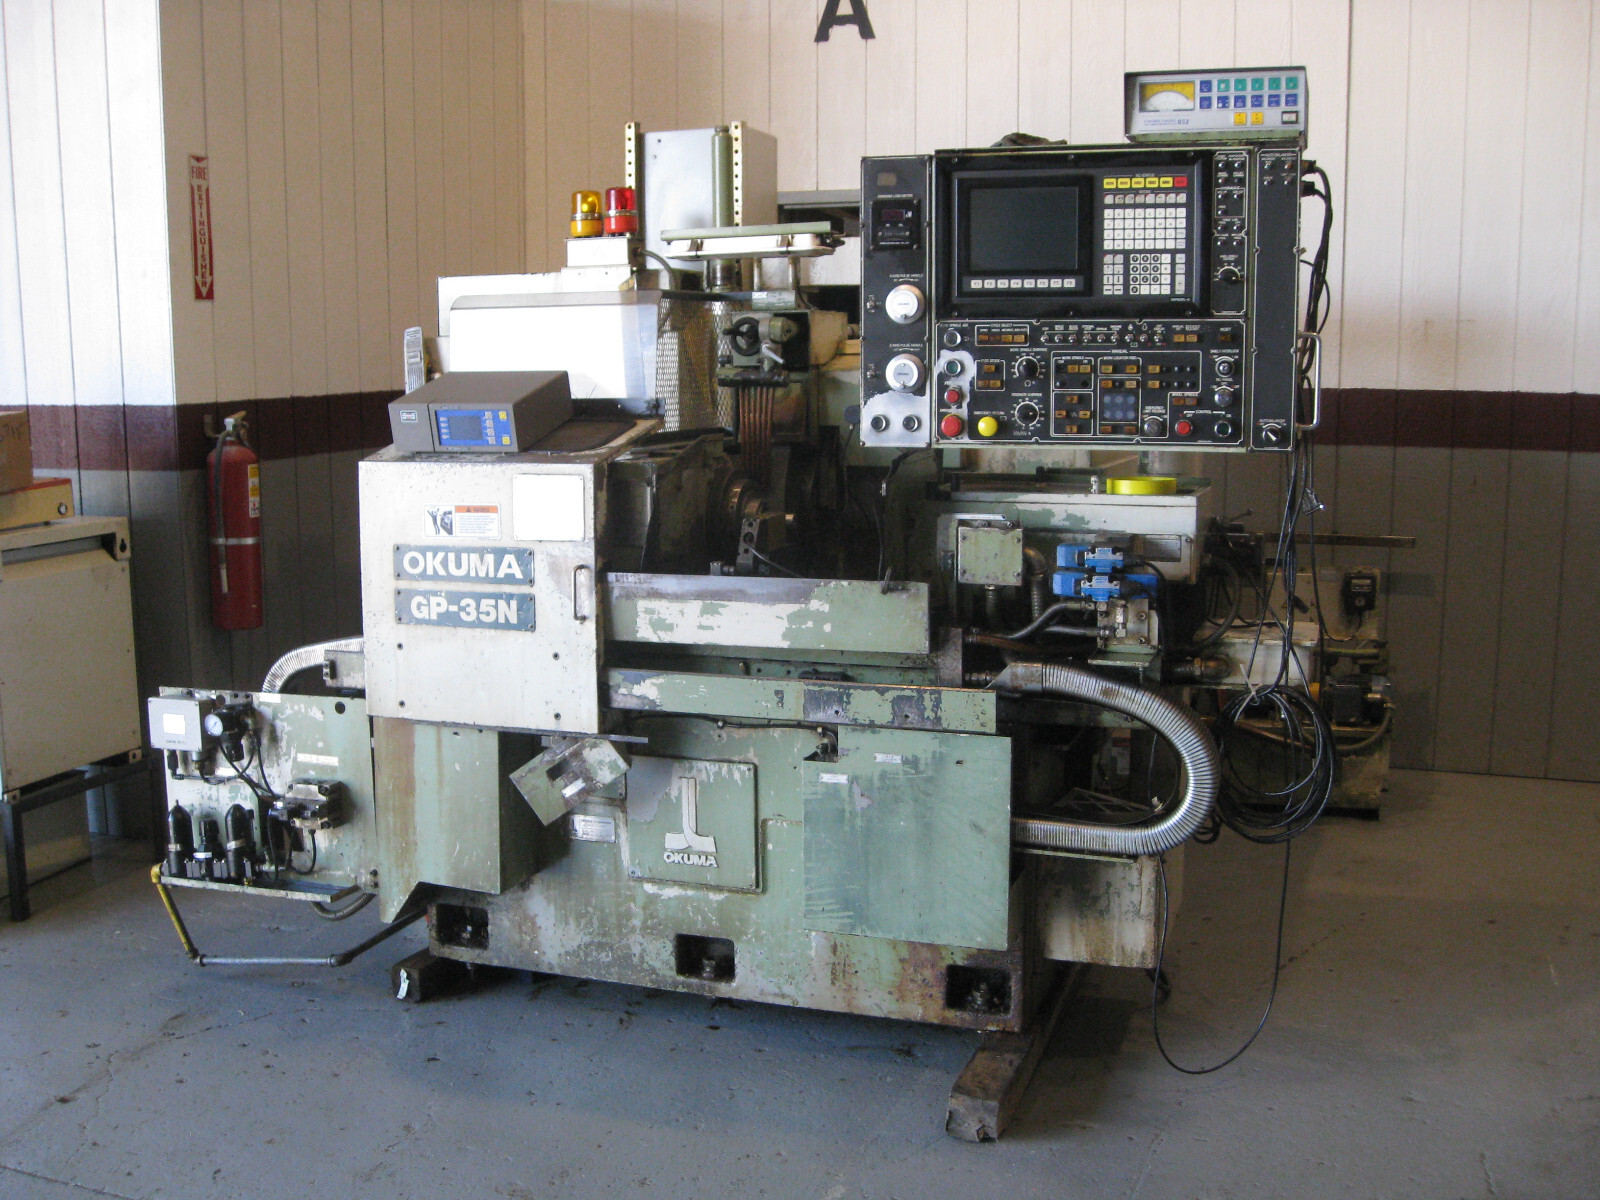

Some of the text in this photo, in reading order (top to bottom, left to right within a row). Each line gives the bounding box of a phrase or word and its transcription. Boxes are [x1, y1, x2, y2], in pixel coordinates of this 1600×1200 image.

[813, 0, 876, 42] A
[191, 166, 208, 181] FIRE
[197, 184, 207, 288] EXTINGUISHER
[402, 550, 524, 580] OKUMA
[410, 595, 518, 624] GP-35N
[663, 851, 719, 868] OKUMA
